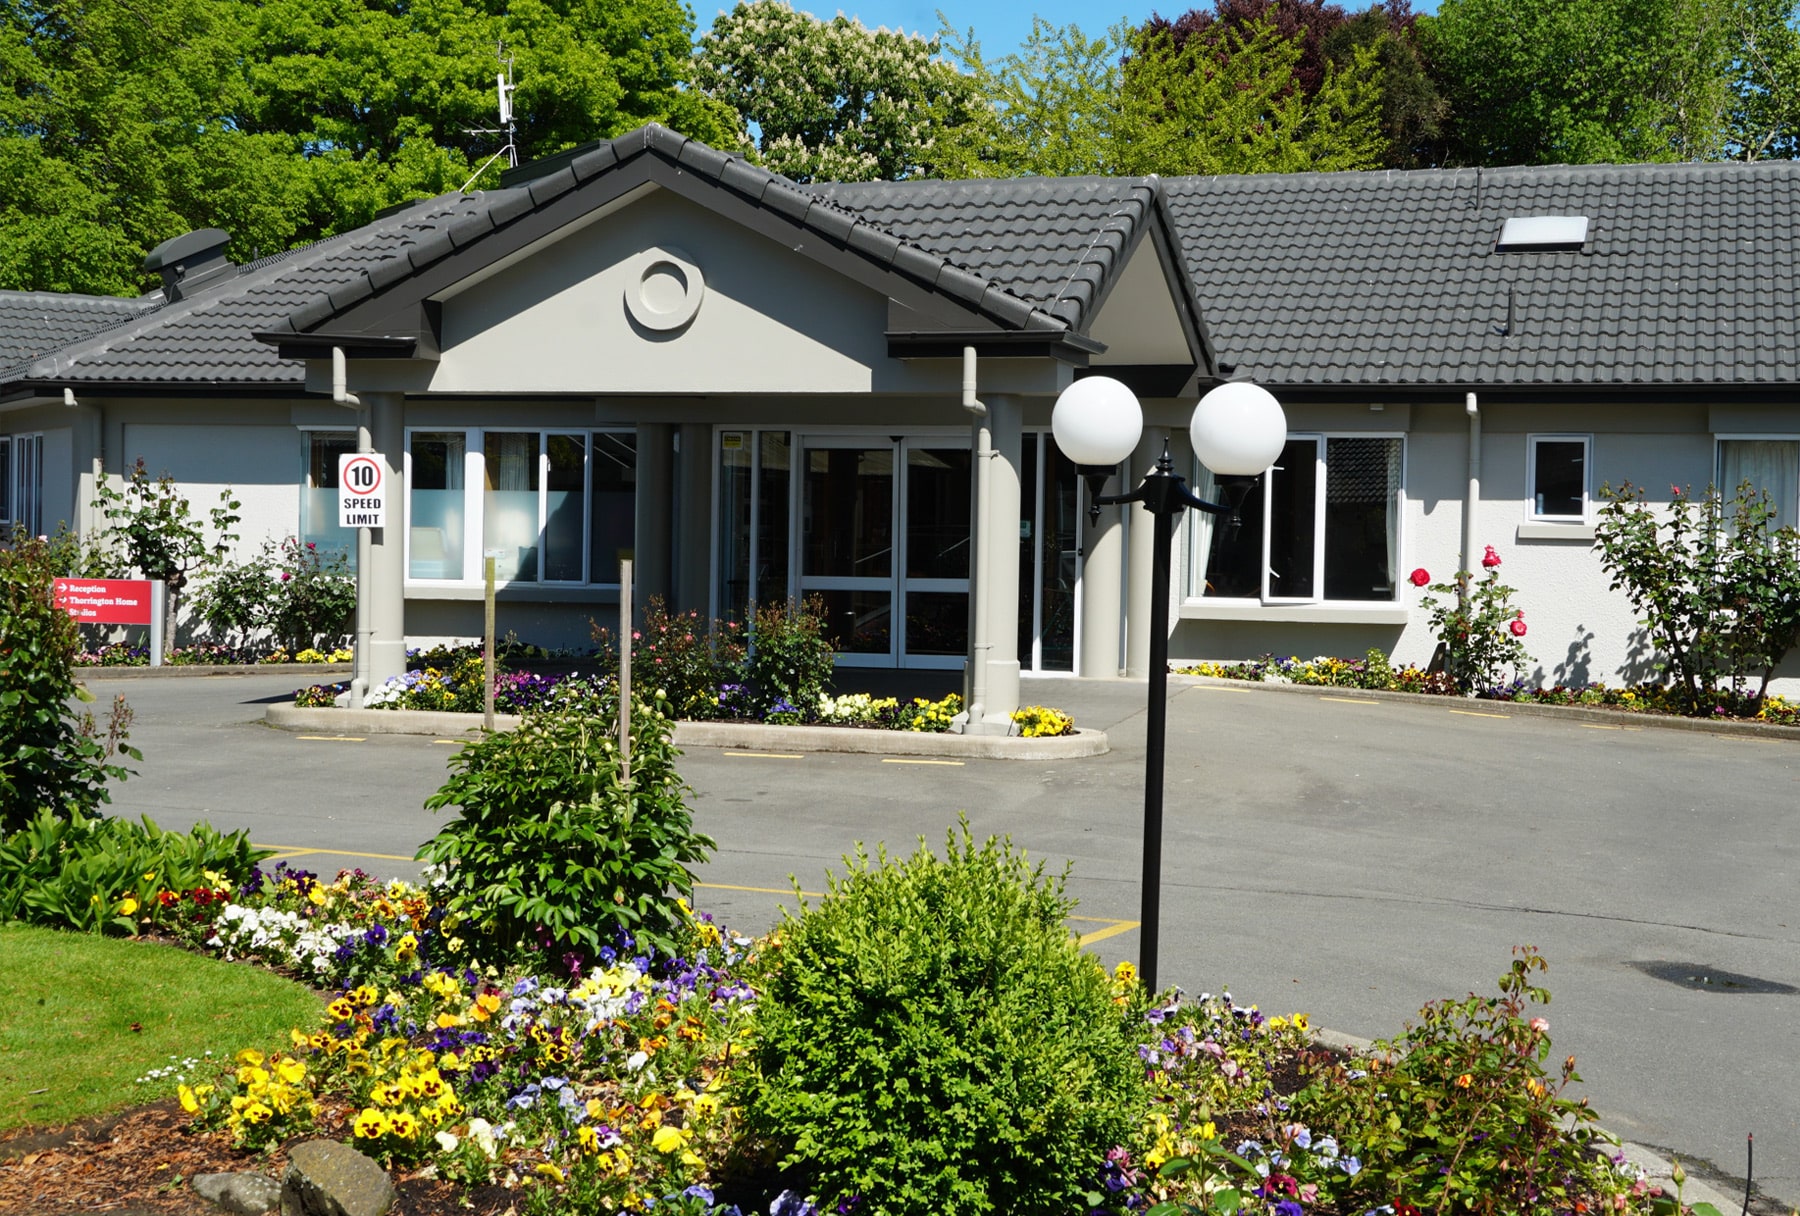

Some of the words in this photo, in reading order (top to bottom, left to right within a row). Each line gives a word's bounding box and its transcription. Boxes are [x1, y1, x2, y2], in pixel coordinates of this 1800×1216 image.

[351, 466, 373, 486] 10
[344, 498, 381, 509] SPEED
[346, 514, 379, 525] LIMIT
[69, 584, 106, 594] Reception
[69, 596, 113, 606] Thorrington
[115, 597, 138, 606] Home
[69, 608, 96, 617] Stdios
